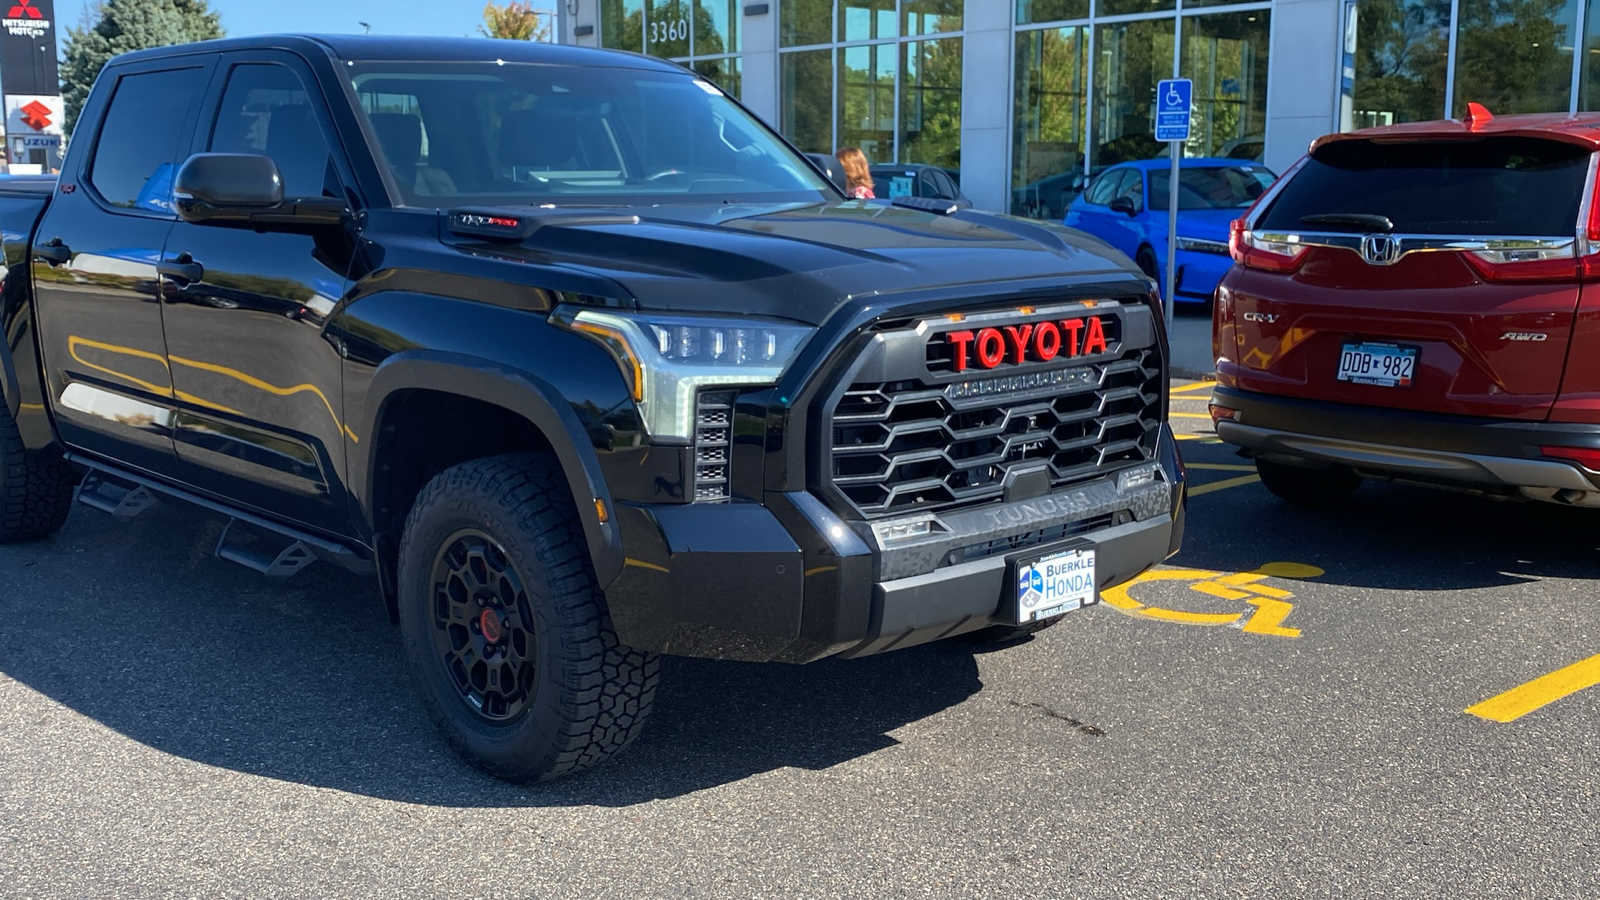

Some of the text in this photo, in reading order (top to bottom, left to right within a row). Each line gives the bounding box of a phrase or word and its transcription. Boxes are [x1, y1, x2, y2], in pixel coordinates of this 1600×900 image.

[2, 19, 50, 28] MITSUBISHI
[650, 19, 688, 43] 3360
[1243, 312, 1280, 323] CR-V
[946, 316, 1107, 373] TOYOTA
[1499, 332, 1547, 341] AWD
[1341, 352, 1412, 378] DDB 982
[984, 492, 1092, 525] TUNDRA
[1046, 557, 1094, 578] BUERKLE
[1046, 572, 1093, 600] HONDA
[1037, 604, 1063, 619] BUERKLE
[468, 694, 482, 708] PRO
